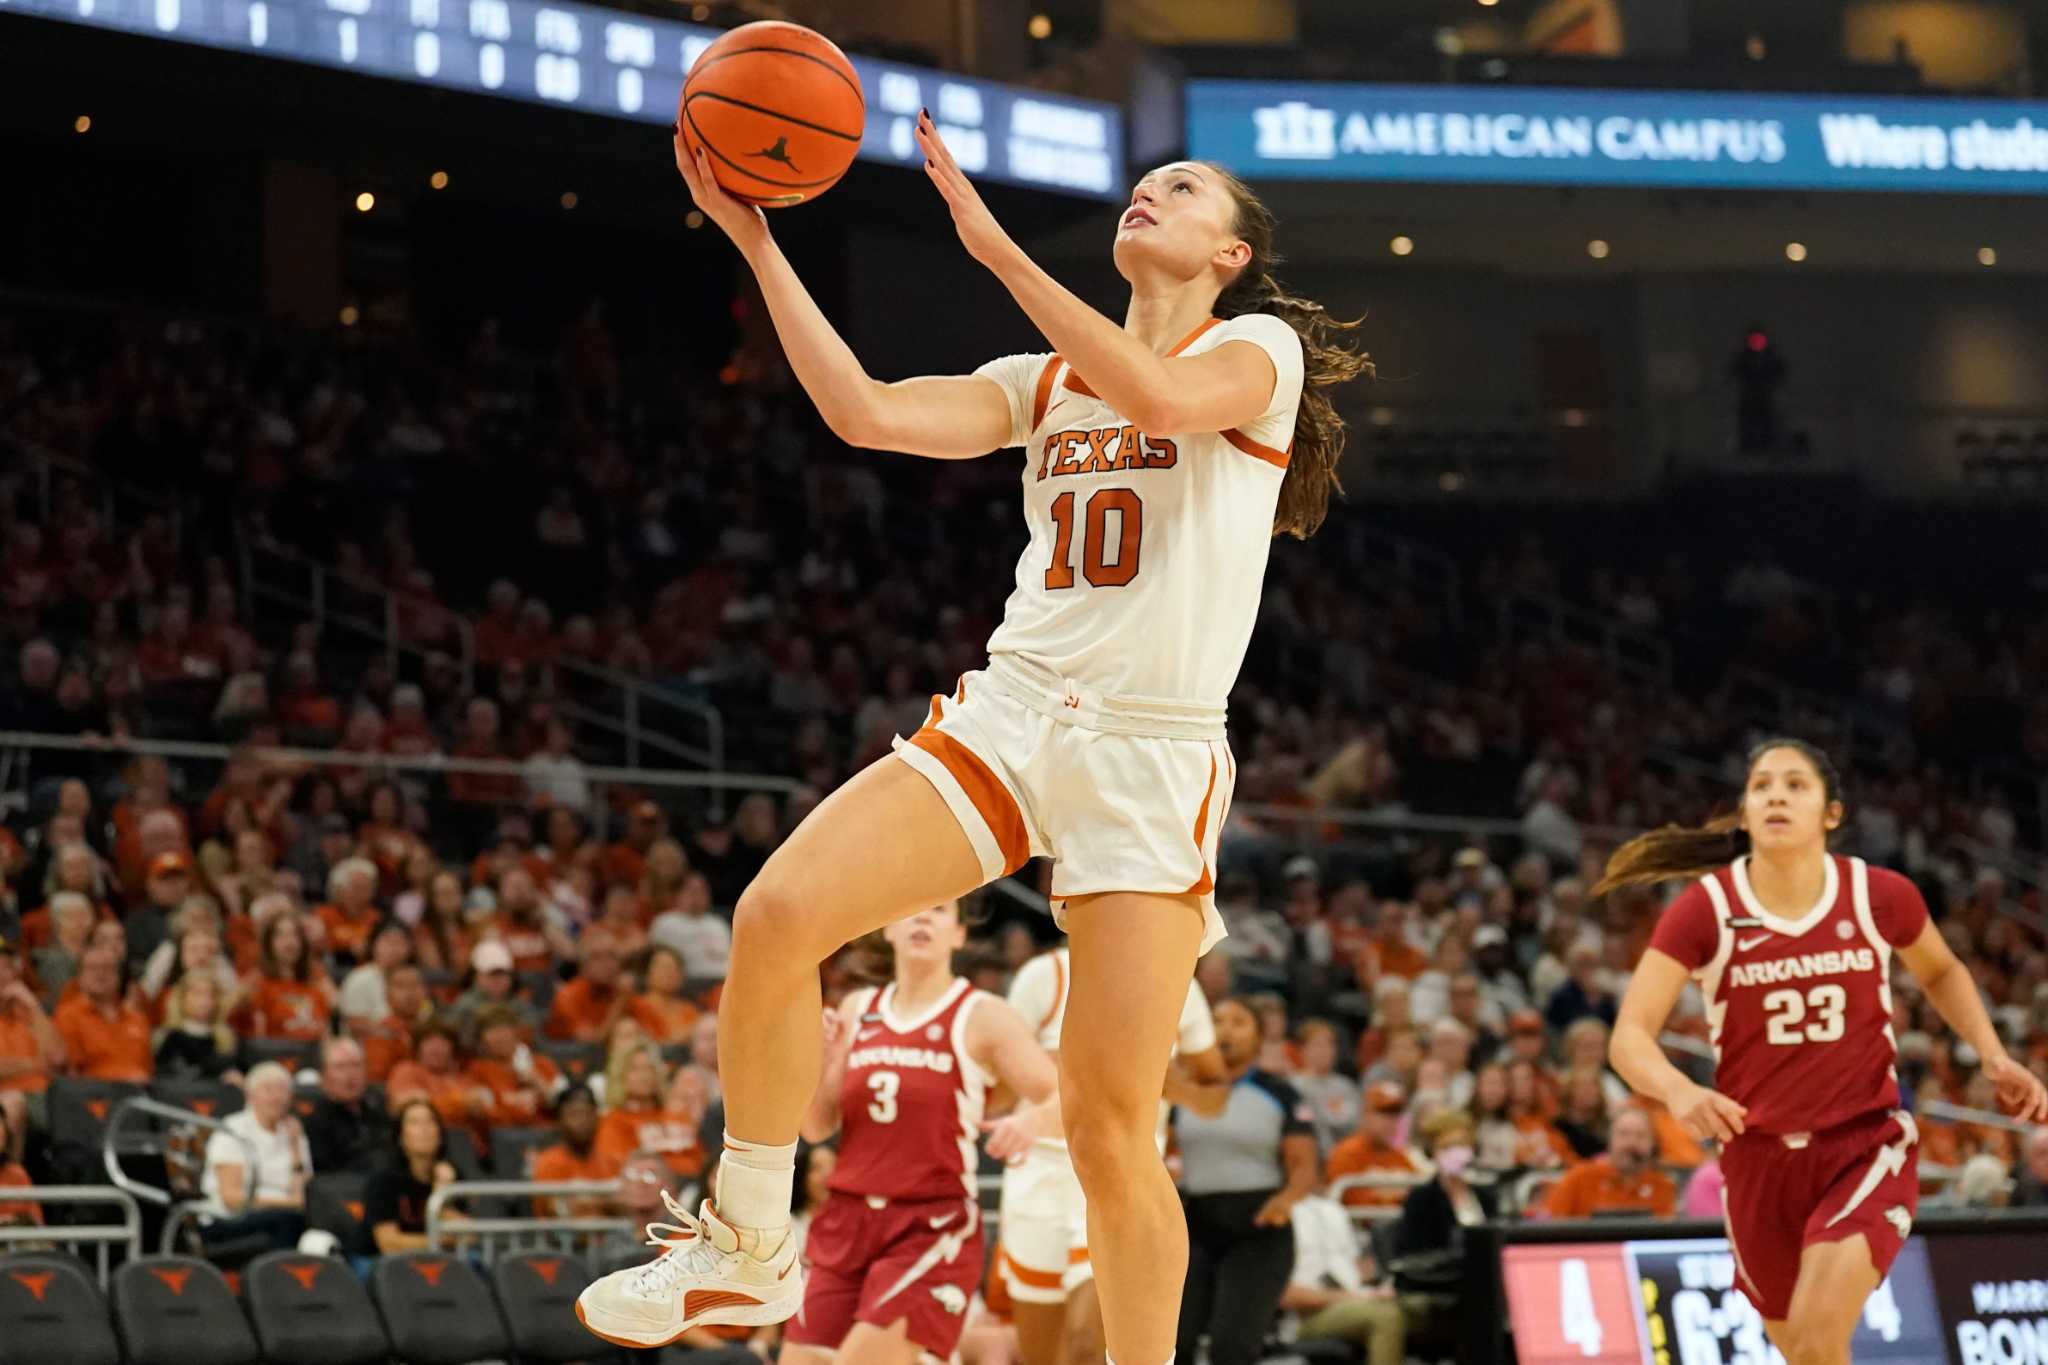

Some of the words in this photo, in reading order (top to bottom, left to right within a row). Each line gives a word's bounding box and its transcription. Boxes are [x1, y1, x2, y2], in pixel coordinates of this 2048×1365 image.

[1339, 111, 1593, 158] AMERICAN
[1596, 116, 1787, 163] CAMPUS
[1818, 113, 1948, 170] Where
[1037, 425, 1178, 482] TEXAS
[1045, 488, 1143, 590] 10
[1730, 948, 1874, 987] ARKANSAS
[1763, 984, 1847, 1045] 23
[867, 1070, 901, 1124] 3
[1560, 1258, 1602, 1356] 4
